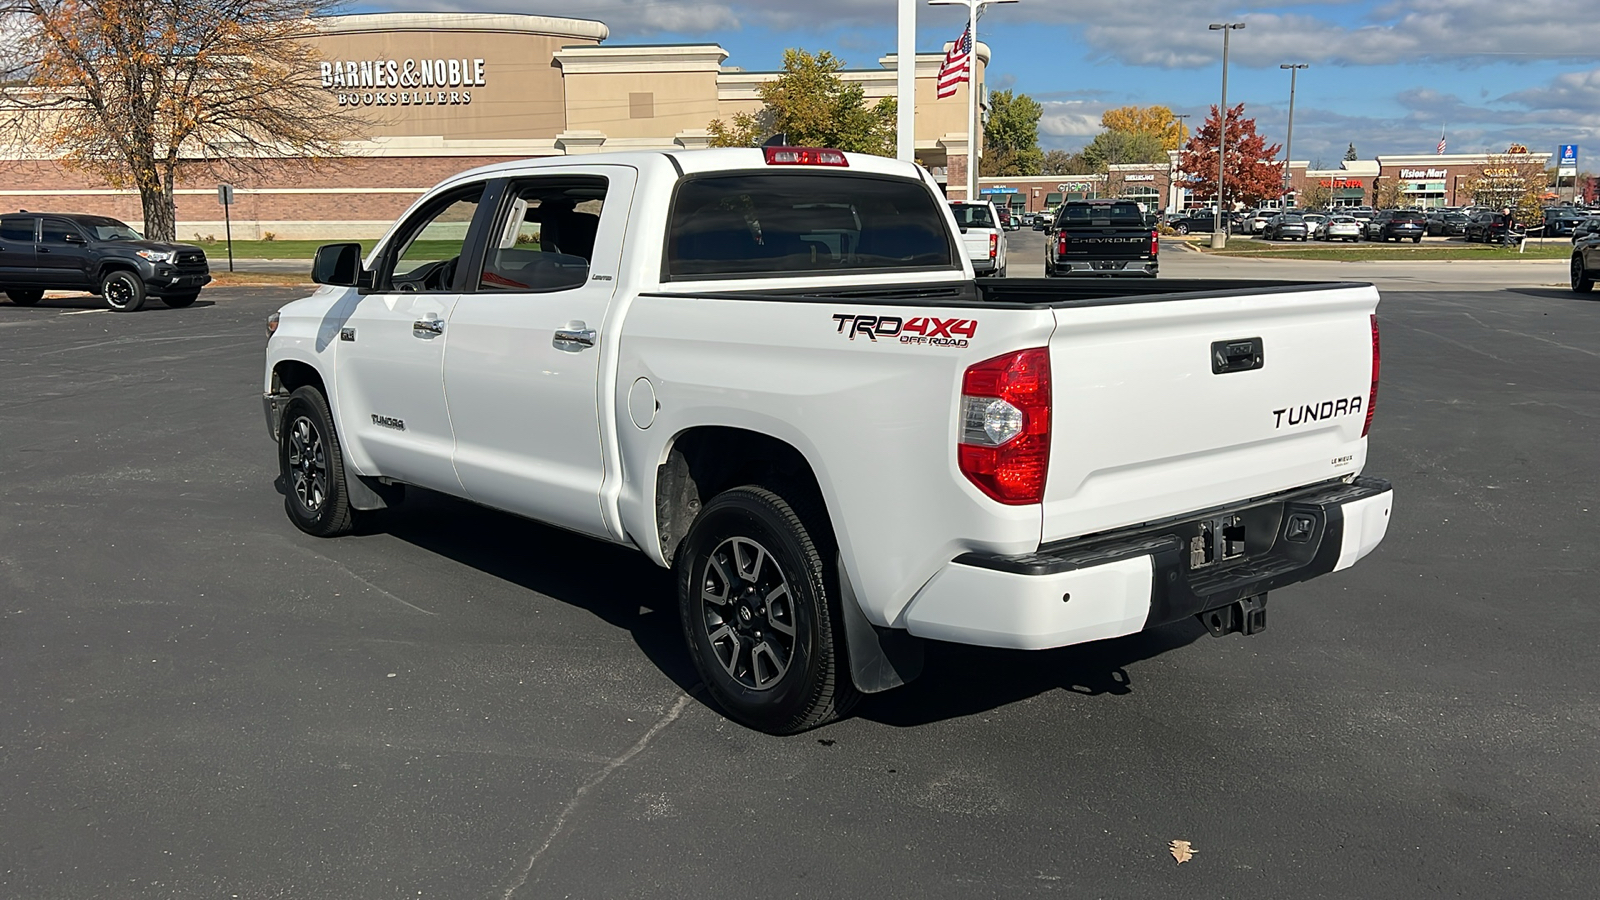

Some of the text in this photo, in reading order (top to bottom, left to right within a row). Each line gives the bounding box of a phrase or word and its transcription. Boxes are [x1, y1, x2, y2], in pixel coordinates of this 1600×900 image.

[338, 91, 472, 106] BOOKSELLERS
[1058, 182, 1092, 192] cricket
[832, 314, 902, 342] TRD
[900, 336, 969, 348] OFF ROAD
[1273, 396, 1362, 429] TUNDRA
[371, 413, 406, 431] TUNDRA
